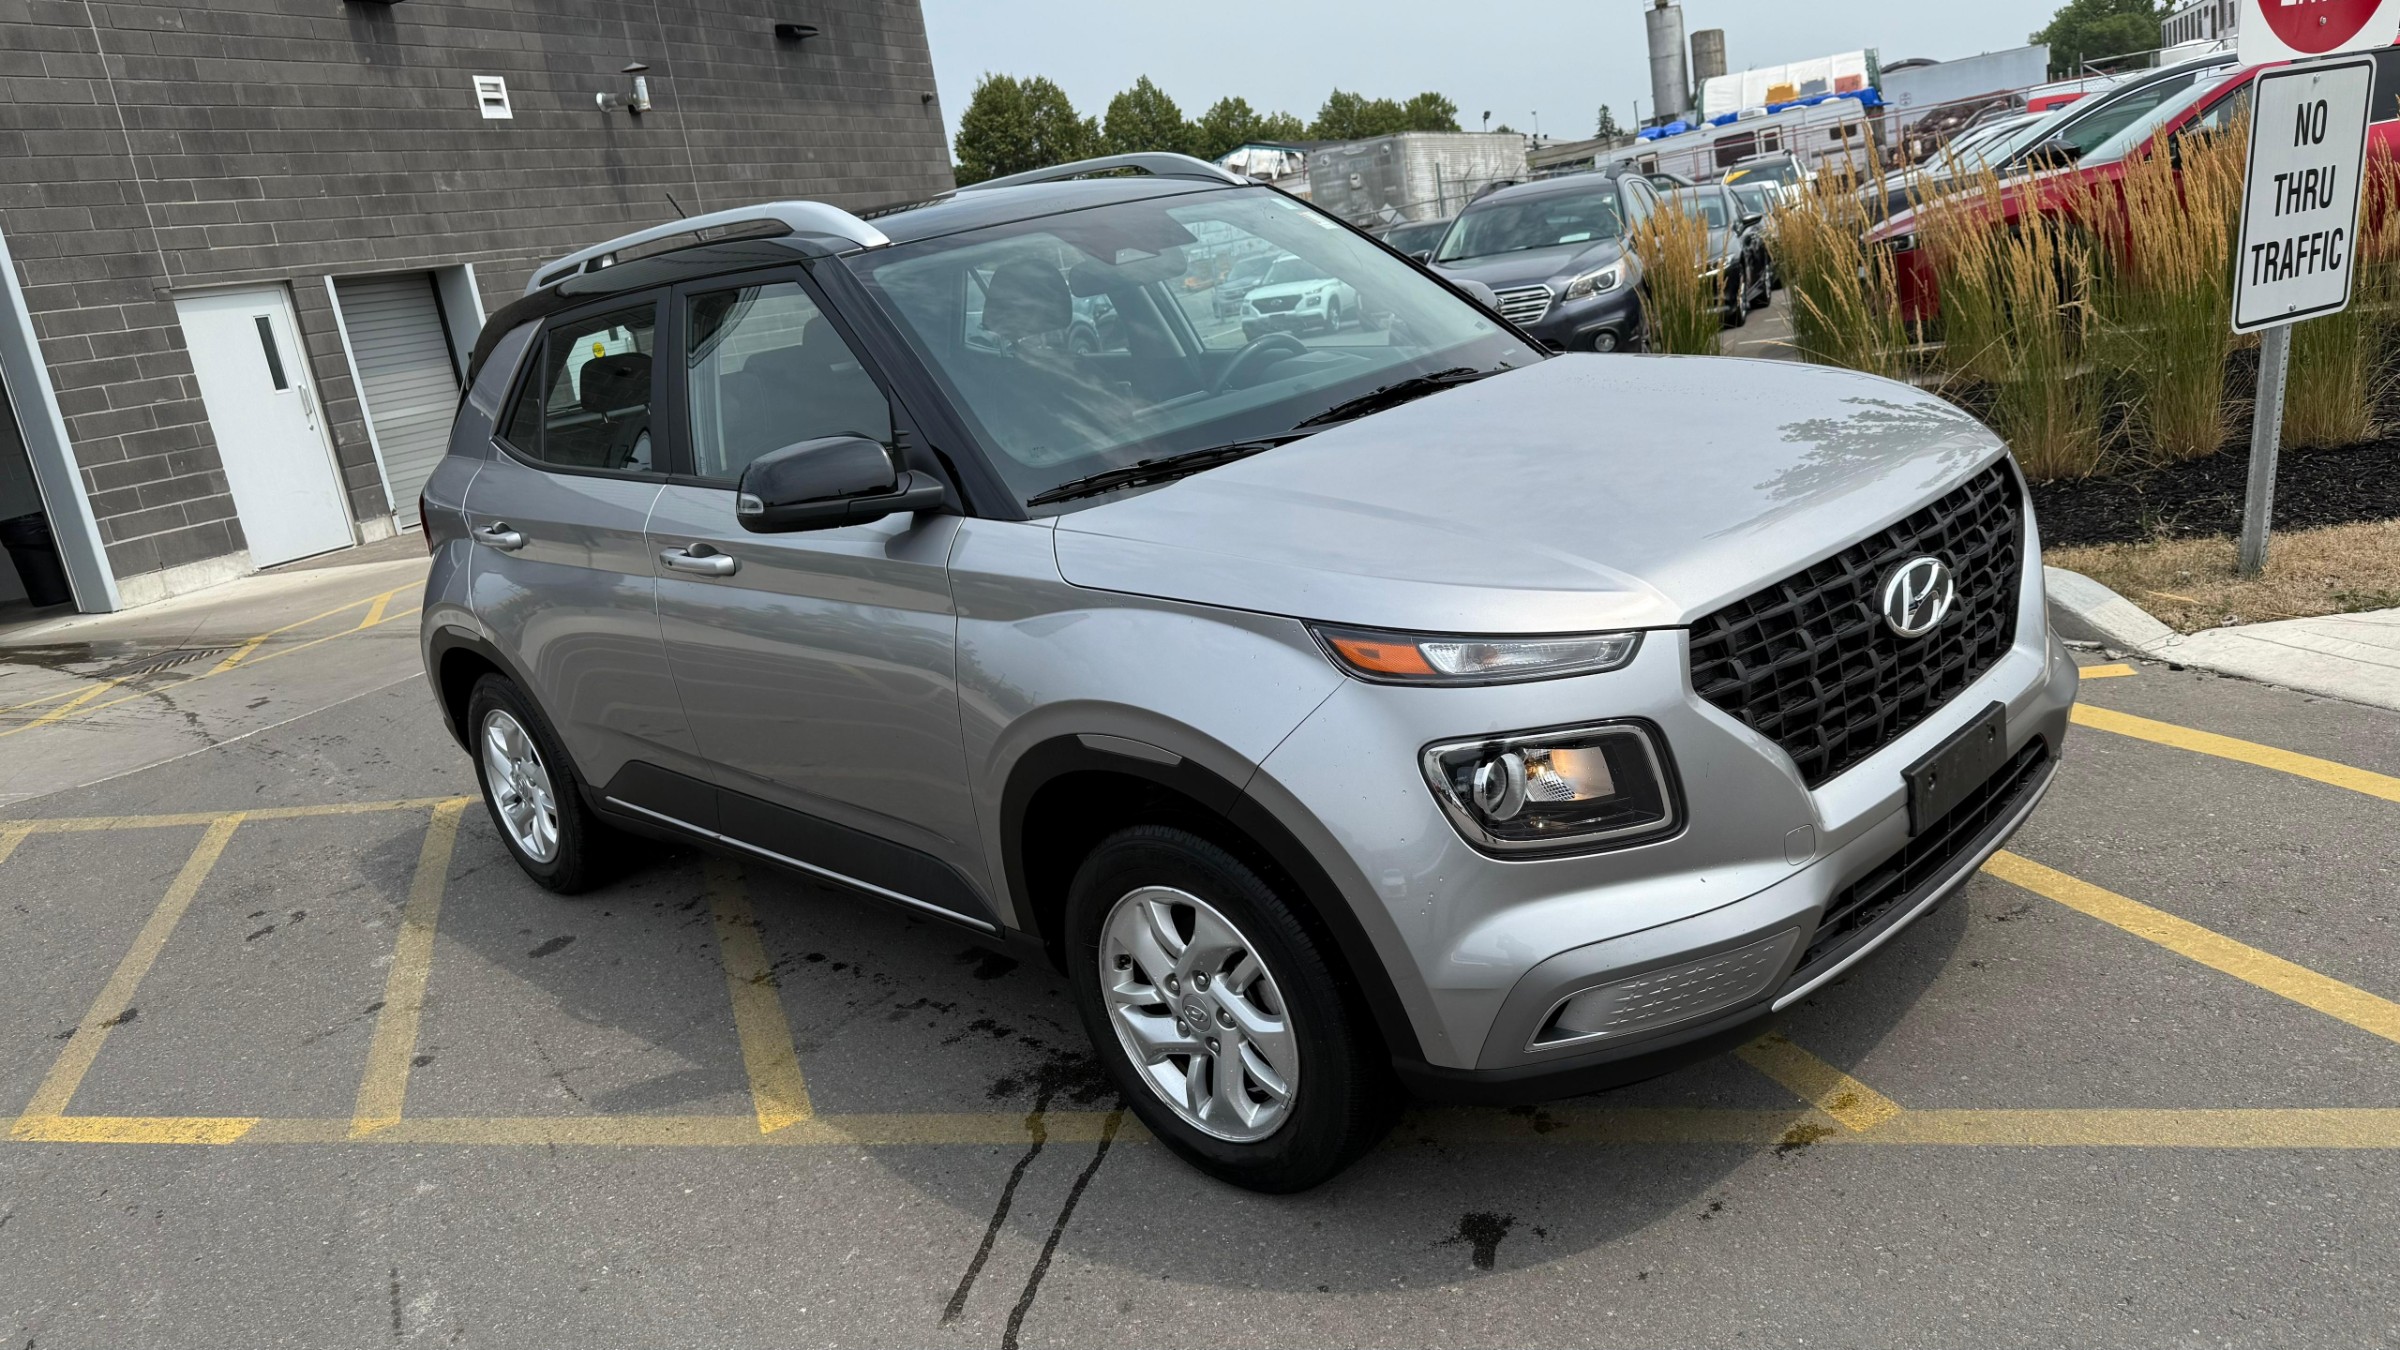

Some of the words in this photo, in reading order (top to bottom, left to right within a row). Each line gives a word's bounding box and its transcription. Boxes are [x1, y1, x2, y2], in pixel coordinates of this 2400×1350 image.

[2293, 99, 2328, 147] NO
[2273, 165, 2336, 217] THRU
[2251, 227, 2344, 287] TRAFFIC
